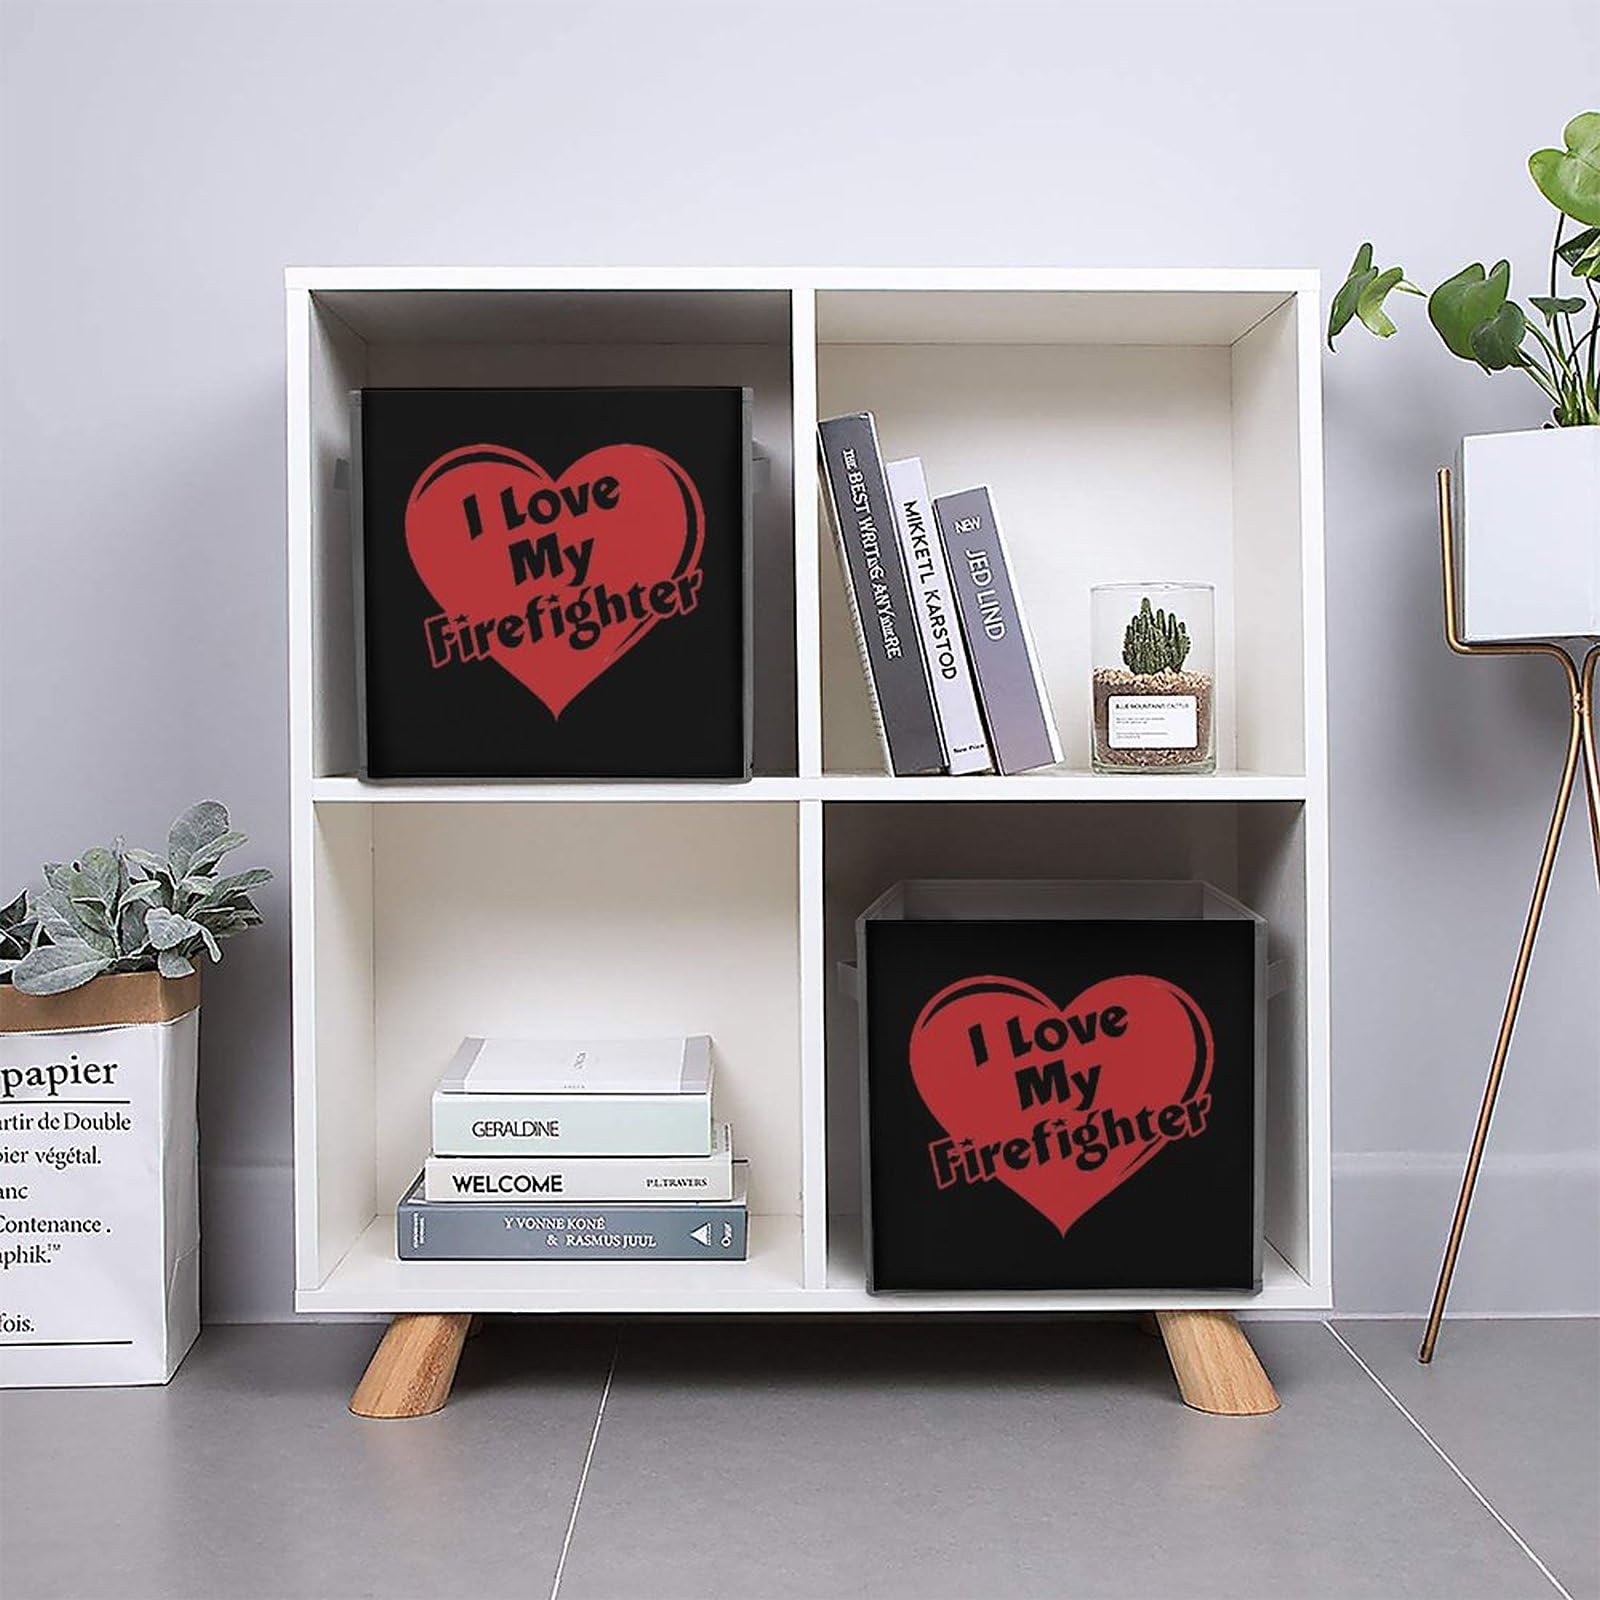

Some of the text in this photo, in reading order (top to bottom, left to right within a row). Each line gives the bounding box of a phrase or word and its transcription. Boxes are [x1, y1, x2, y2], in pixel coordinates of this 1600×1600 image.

[462, 475, 620, 540] I Love
[847, 471, 870, 512] BEST
[954, 516, 981, 534] NEW
[508, 532, 595, 587] My
[903, 500, 957, 680] MIKKETL KARSTOD
[965, 548, 1007, 641] JED LIND
[426, 570, 702, 667] Firefighter
[968, 1005, 1129, 1067] I Love
[1, 1055, 118, 1098] papier
[1014, 1060, 1102, 1111] My
[37, 1111, 60, 1131] de
[63, 1111, 131, 1131] Double
[472, 1121, 559, 1138] GERALDINE
[930, 1095, 1211, 1189] Firefighter
[35, 1145, 102, 1171] végétal.
[452, 1174, 563, 1193] WELCOME
[546, 1234, 656, 1248] & RASMUS JUUL
